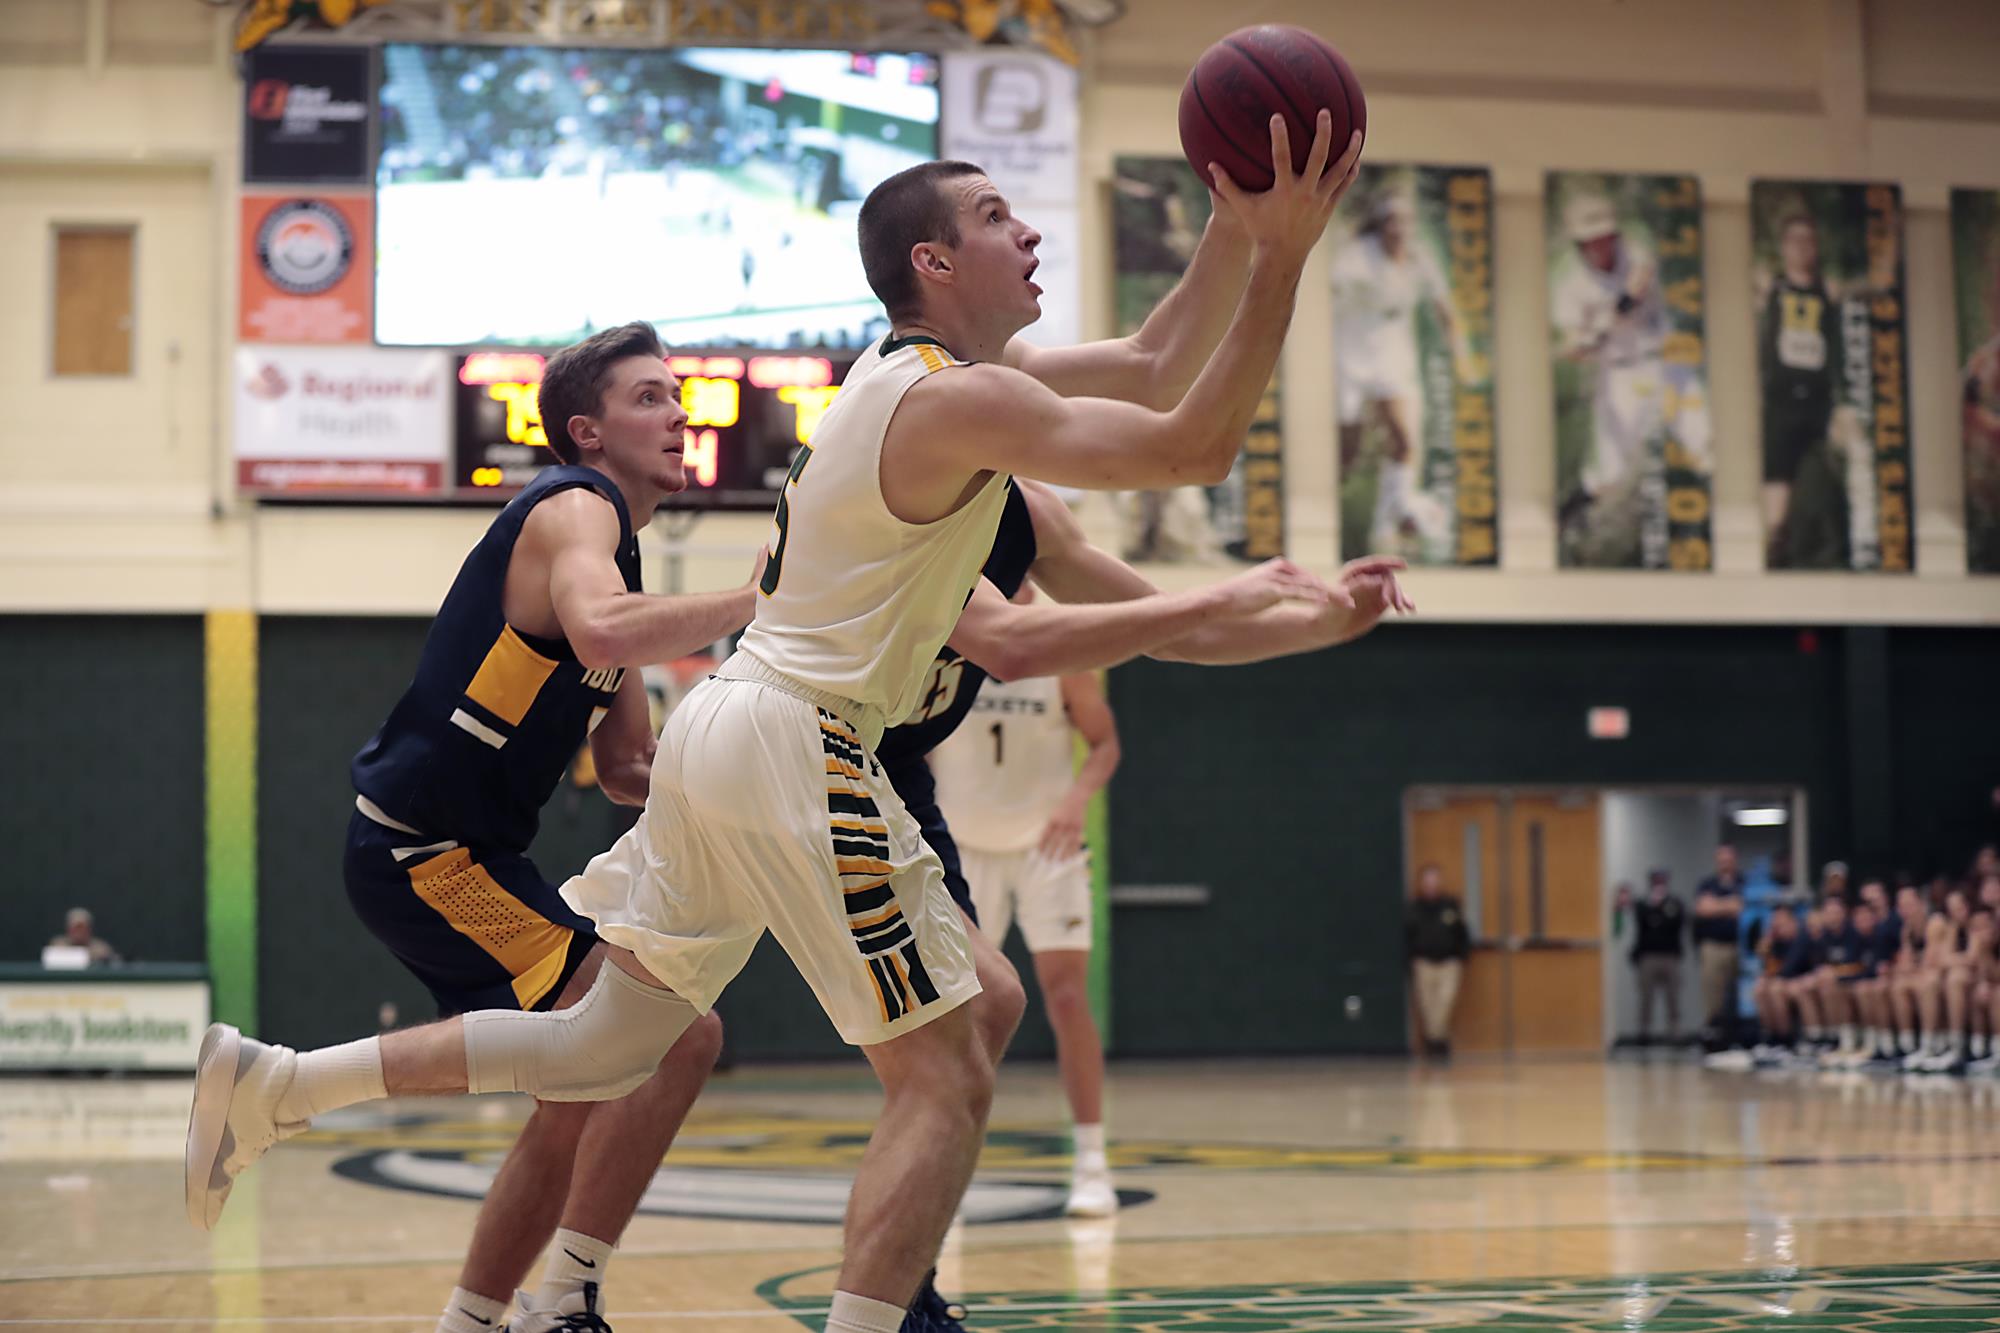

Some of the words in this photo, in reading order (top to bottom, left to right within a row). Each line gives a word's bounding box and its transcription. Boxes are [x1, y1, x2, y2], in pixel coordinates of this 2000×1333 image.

[301, 371, 434, 405] Regional
[1657, 178, 1711, 572] SOFTBALL
[1871, 329, 1906, 453] TRACK
[989, 721, 1006, 767] 1
